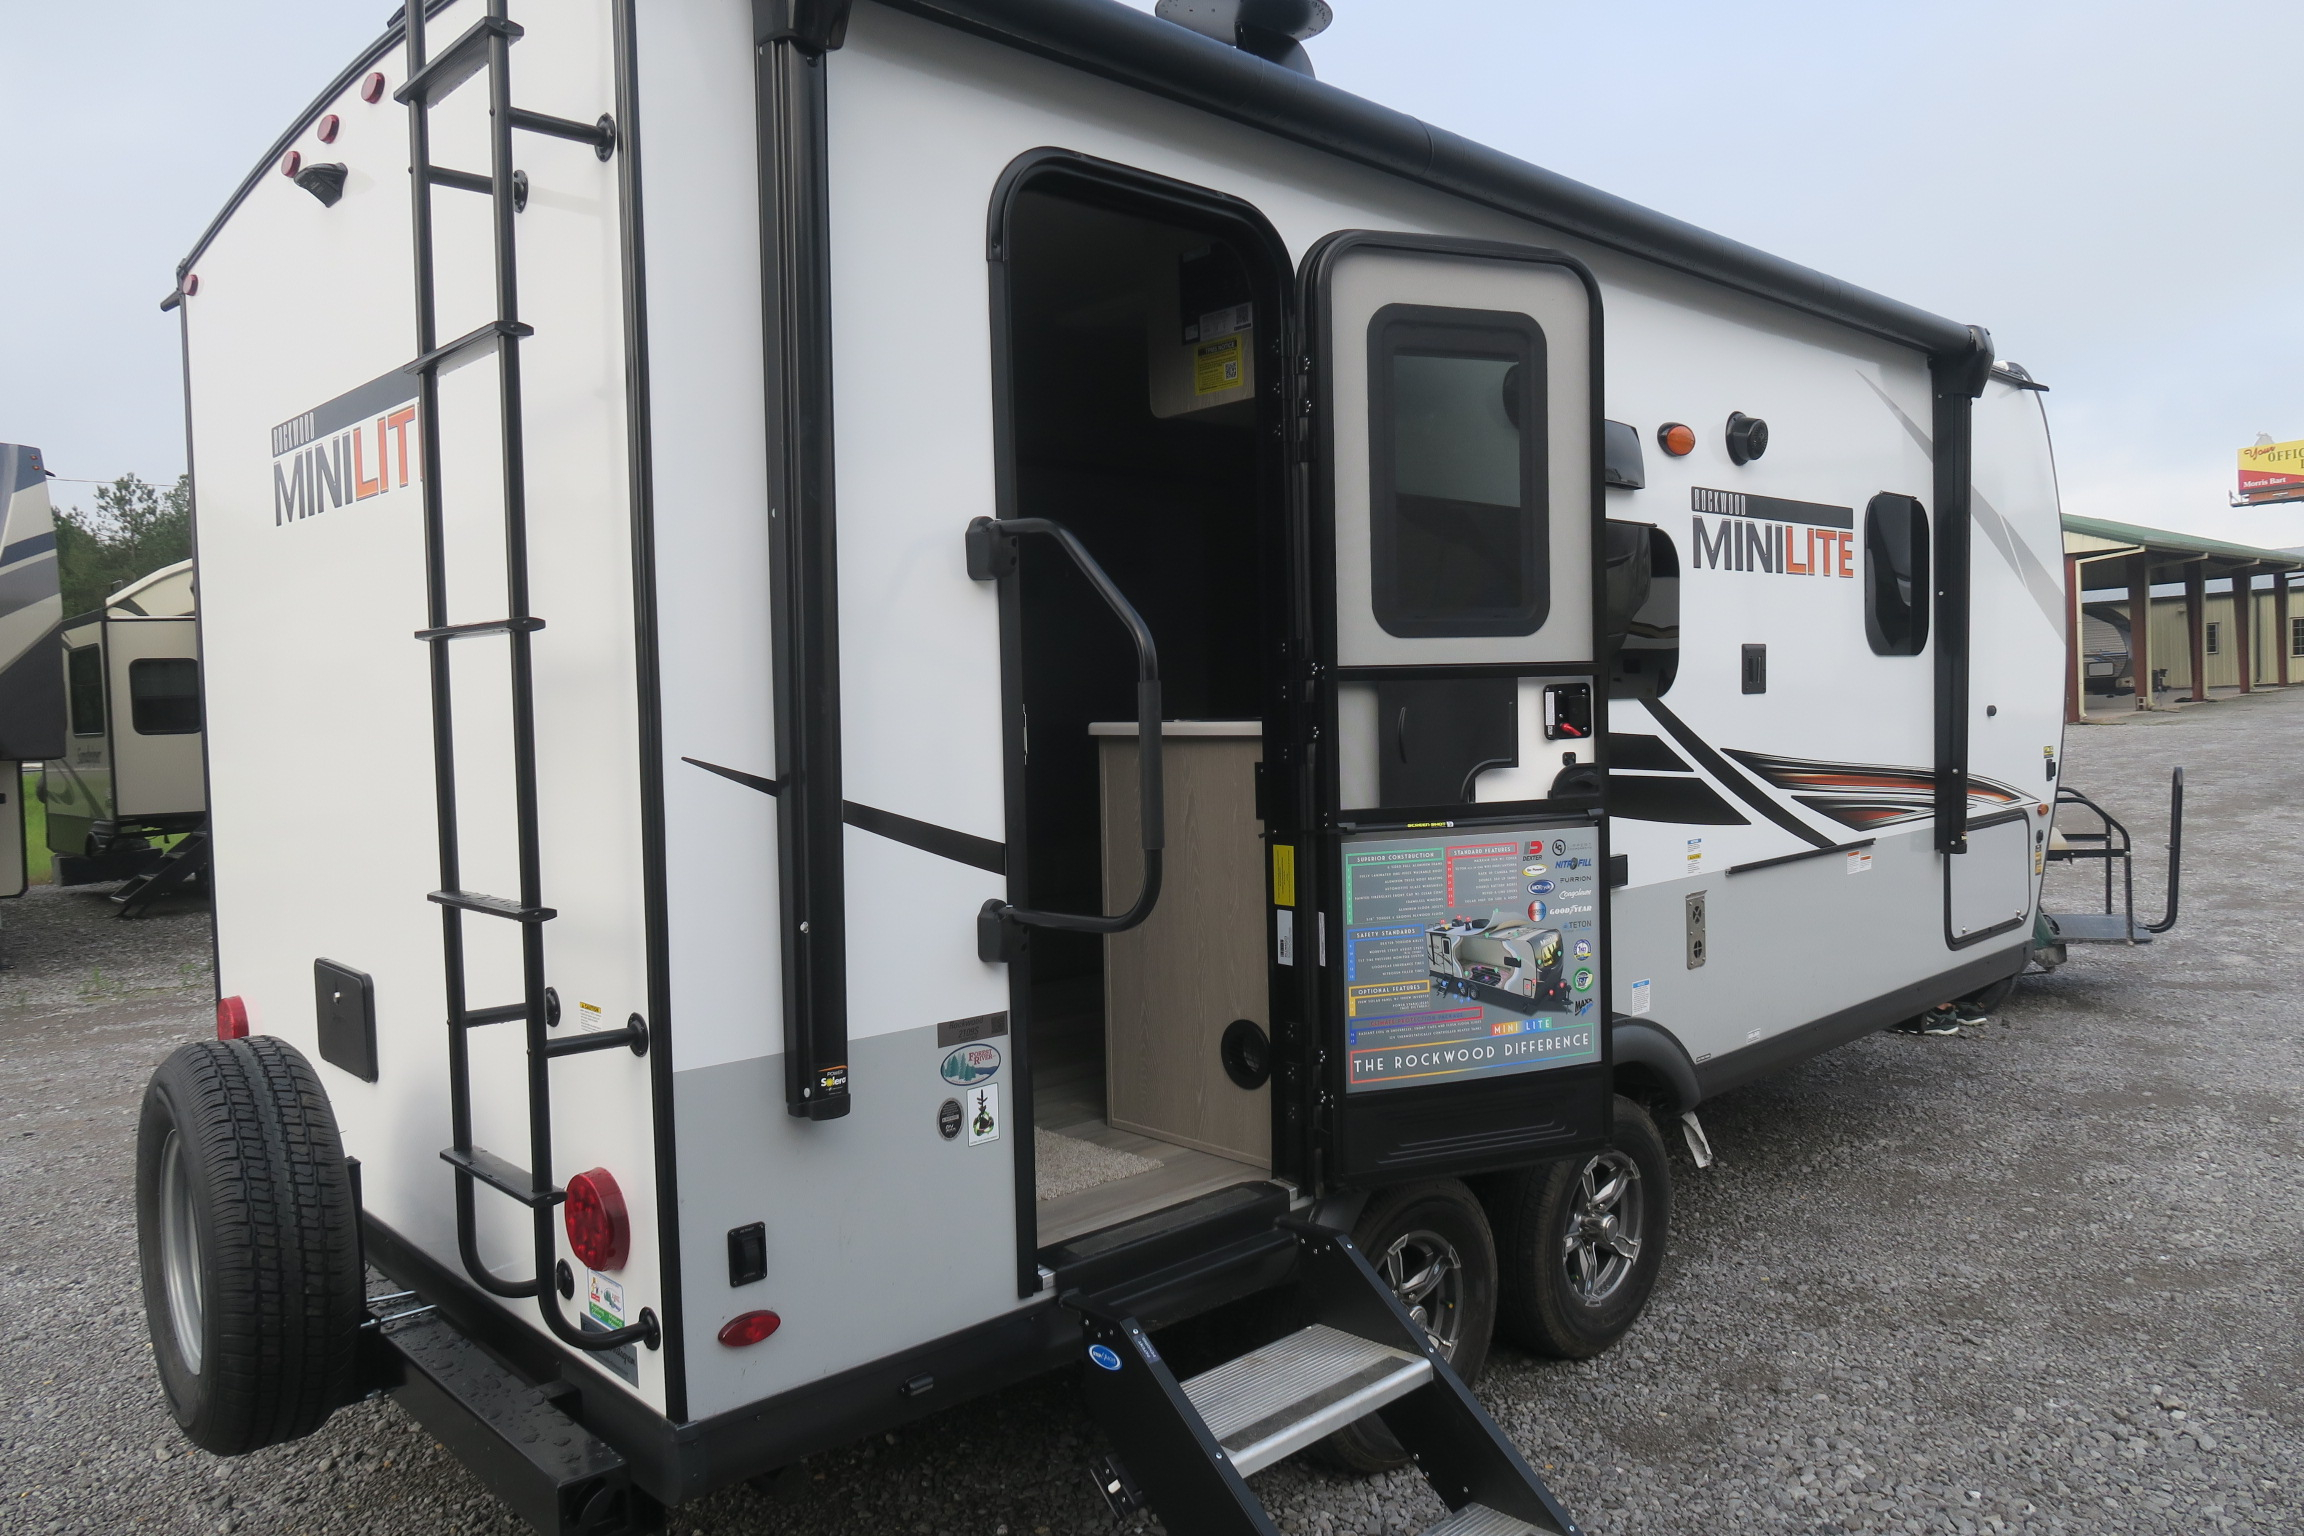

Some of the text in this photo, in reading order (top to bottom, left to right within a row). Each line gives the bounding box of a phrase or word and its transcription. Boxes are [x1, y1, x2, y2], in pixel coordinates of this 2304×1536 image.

[273, 412, 315, 455] ROCKWOOD
[2244, 446, 2276, 460] Your
[273, 402, 423, 527] MINILIT
[2243, 476, 2286, 488] Morris Bart
[1694, 488, 1746, 516] ROCKWOOD
[1388, 852, 1434, 860] CONSTRUCTION
[1550, 904, 1592, 915] GOODYEAR
[1569, 920, 1592, 929] TETON
[1398, 1015, 1436, 1024] PROTECTION
[1494, 1023, 1518, 1034] MINI
[1526, 1019, 1550, 1031] LITE
[968, 1048, 992, 1062] FOREST
[974, 1054, 993, 1065] RIVER
[1354, 1033, 1589, 1072] THE ROCKWOOD DIFFERENCE
